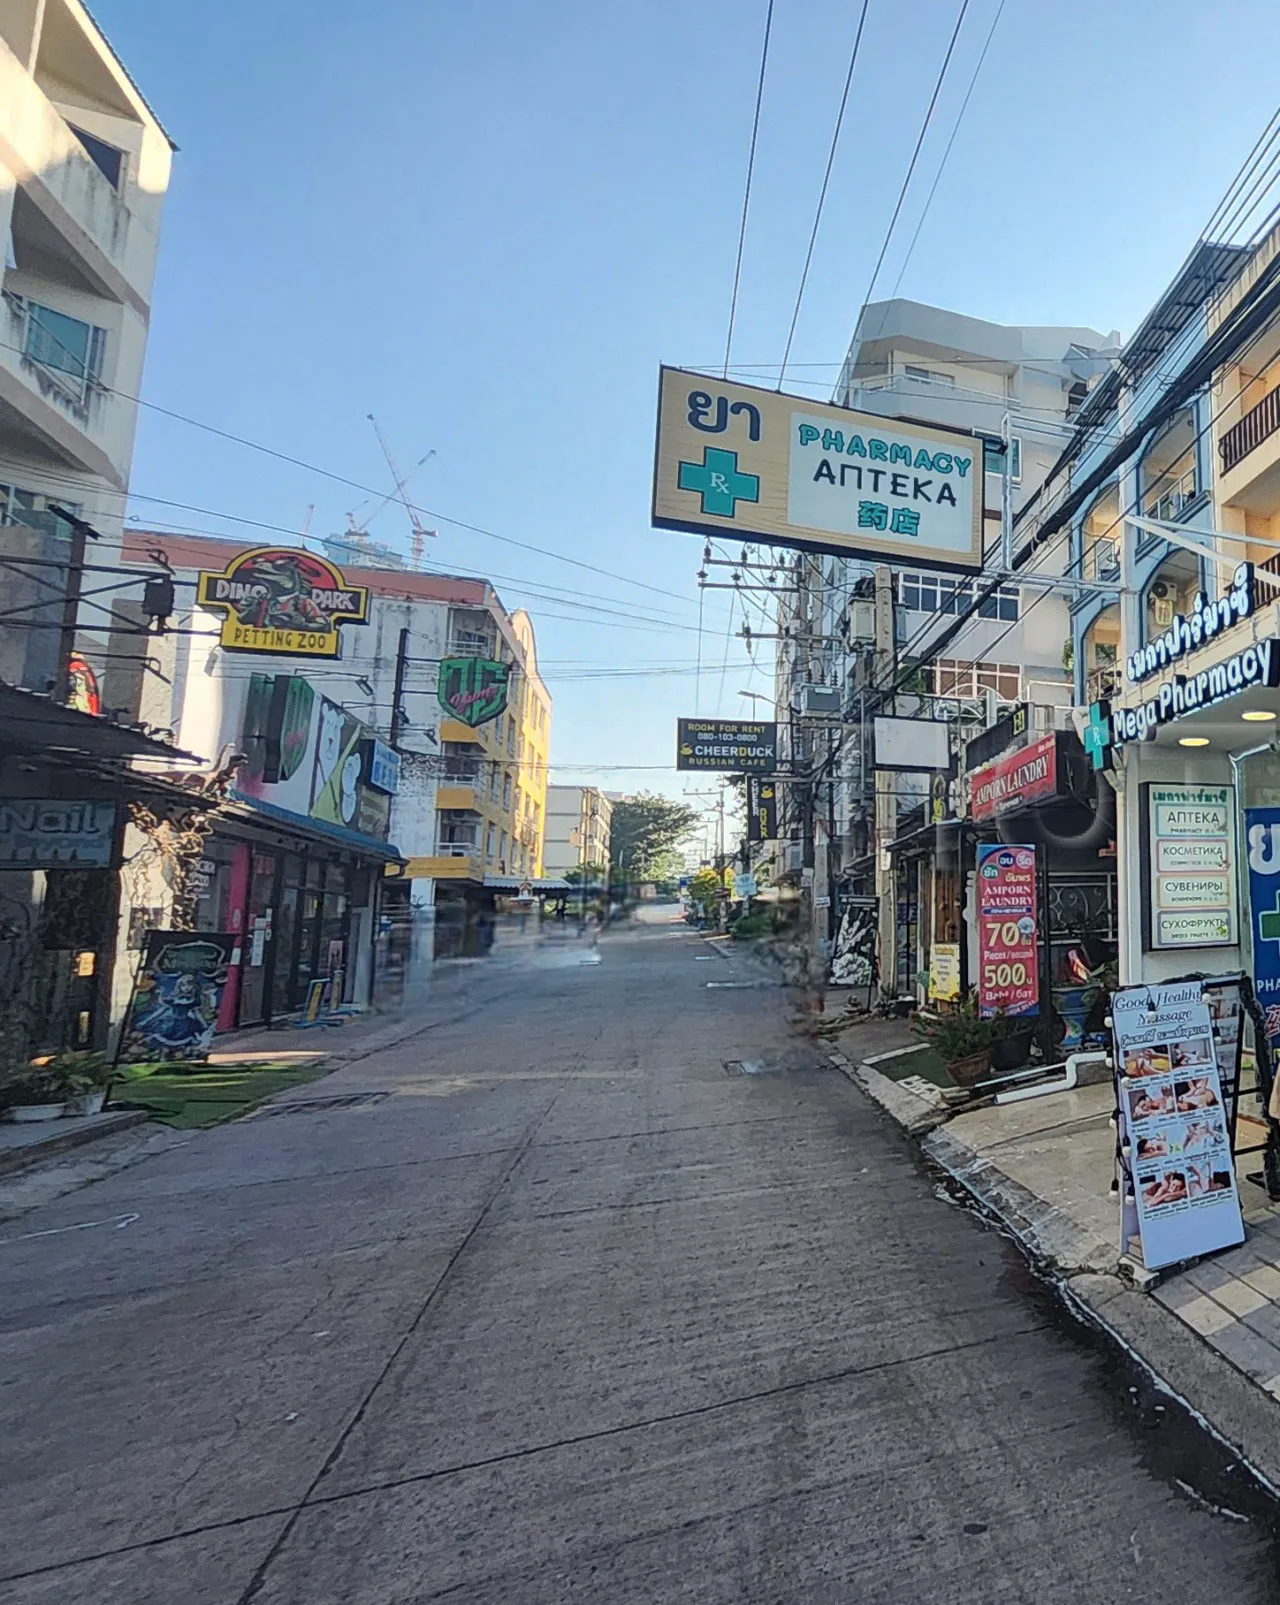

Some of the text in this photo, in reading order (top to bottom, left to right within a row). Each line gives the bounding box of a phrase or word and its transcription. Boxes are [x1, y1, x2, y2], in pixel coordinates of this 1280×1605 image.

[686, 389, 762, 442] ยา
[798, 424, 972, 479] PHARMACY
[813, 459, 958, 507] АПТЕКА
[858, 500, 921, 537] 药店
[312, 588, 355, 611] PARK
[1126, 562, 1252, 682] เมกาฟาร์มาซี
[233, 628, 327, 649] PETTING ZOO
[1113, 638, 1273, 742] Mega Pharmacy
[688, 723, 767, 733] ROOM FOR RENT
[689, 758, 735, 766] RUSSIAN
[695, 745, 773, 757] CHEERDUCK
[975, 775, 1007, 807] AMPORN
[1006, 753, 1051, 792] LAUNDRY
[751, 778, 760, 817] CHEER
[760, 808, 769, 838] DUCK
[1167, 811, 1220, 824] АПТЕКА
[1163, 846, 1223, 856] КОСМЕТИКА
[984, 885, 1031, 895] AMPORN
[1165, 881, 1223, 892] СУВЕНИРЫ
[981, 897, 1033, 907] LAUNDRY
[986, 921, 1020, 947] 70
[984, 963, 1026, 989] 500
[1115, 994, 1151, 1010] Good
[1155, 988, 1203, 1010] Healthy
